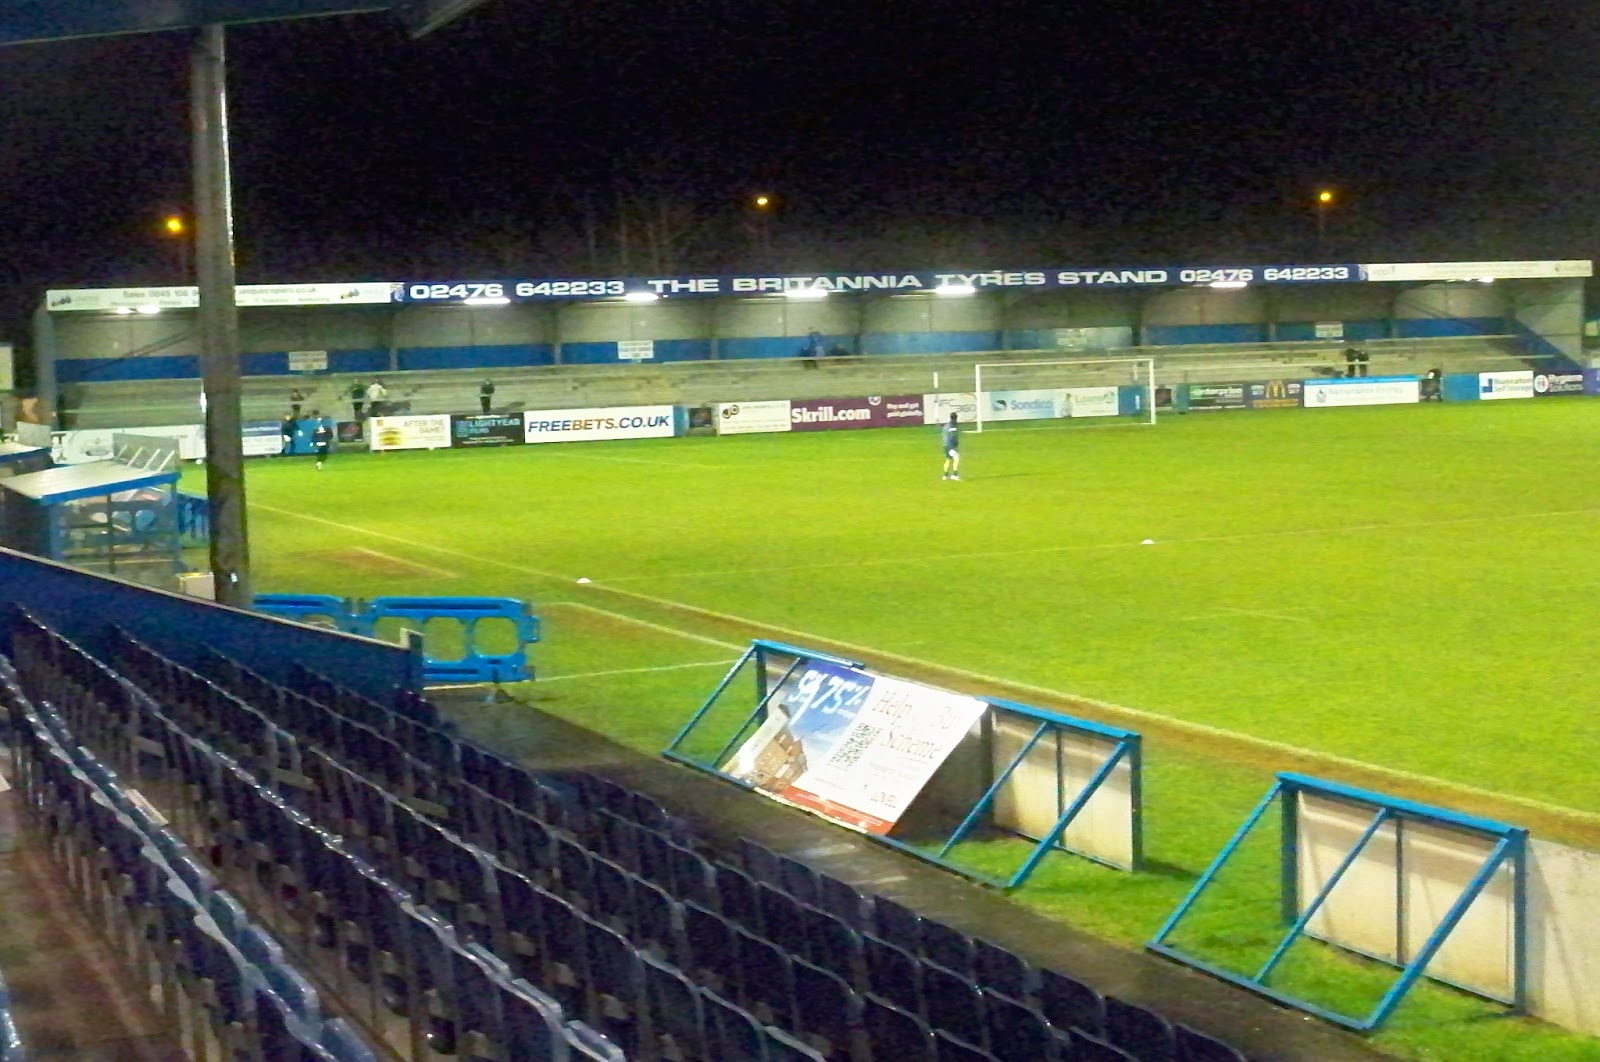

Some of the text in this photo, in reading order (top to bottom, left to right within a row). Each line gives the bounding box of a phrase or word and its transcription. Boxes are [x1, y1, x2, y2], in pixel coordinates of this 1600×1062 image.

[410, 267, 1349, 299] 02476 642233 THE BRITANNIA TYRES STAND 02476 642233
[528, 415, 670, 432] FREEBETS.CO.UK
[791, 405, 871, 423] Skrill.com
[872, 690, 913, 726] Help
[880, 725, 944, 760] Scheme
